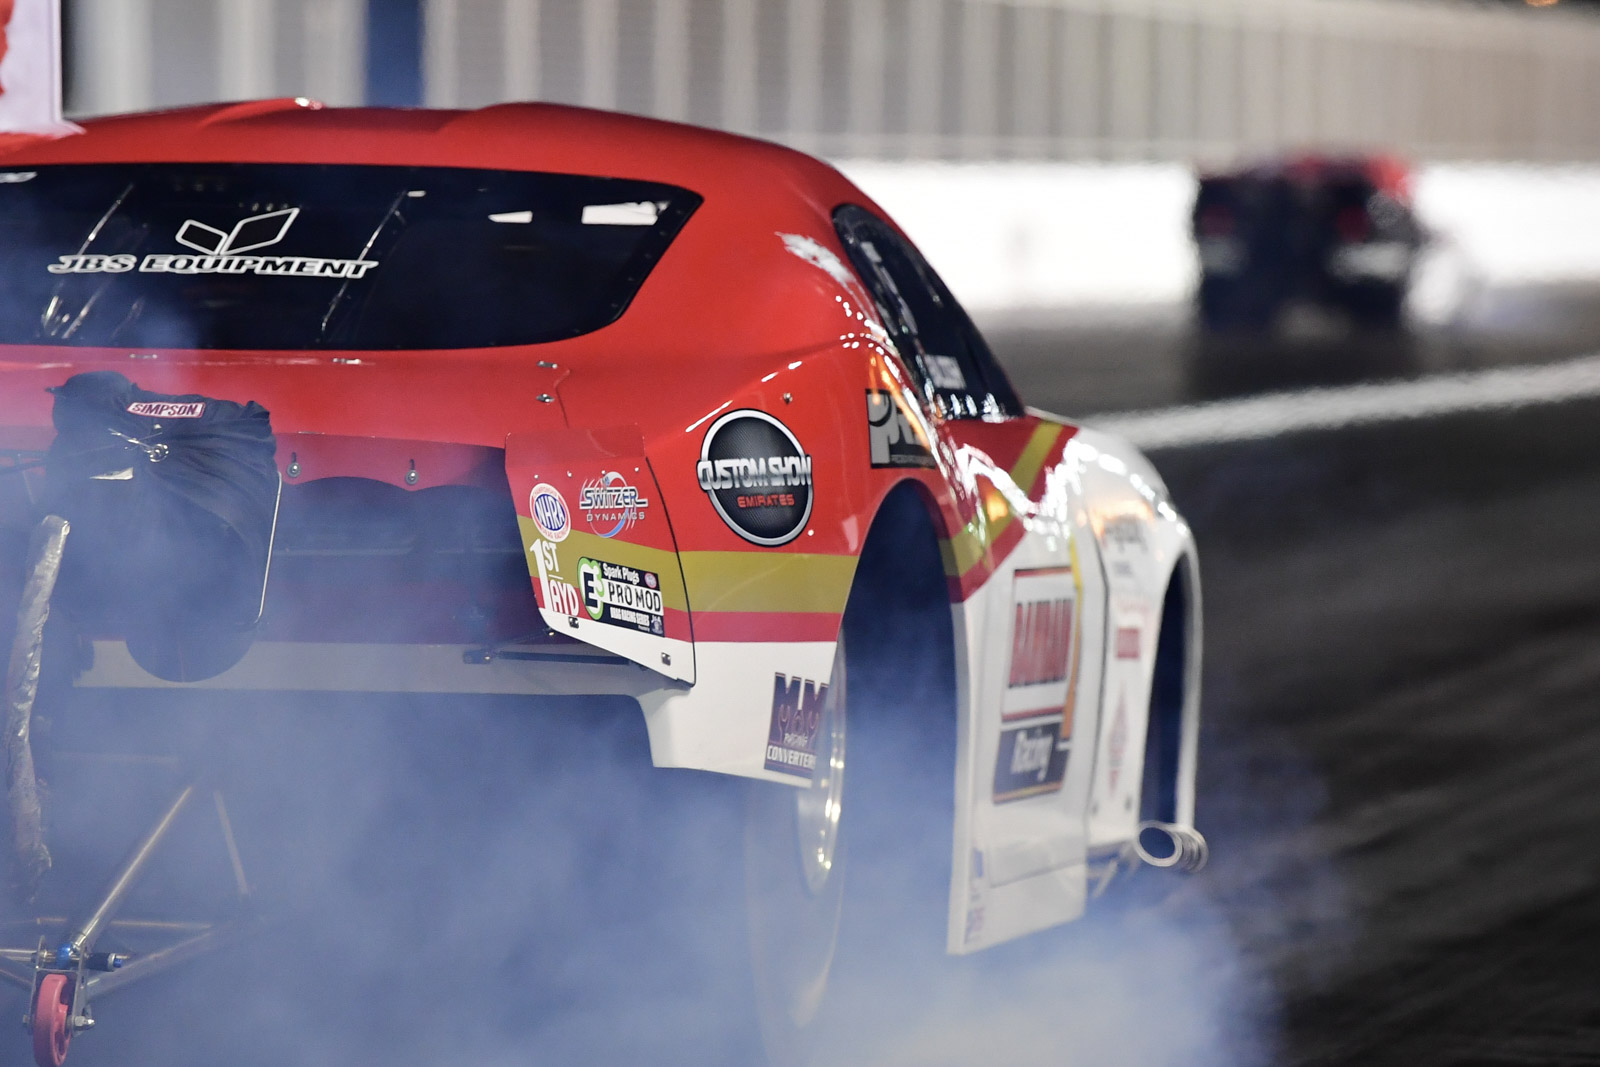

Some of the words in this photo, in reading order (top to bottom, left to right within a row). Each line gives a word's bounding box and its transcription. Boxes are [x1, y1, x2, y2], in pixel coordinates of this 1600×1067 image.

[47, 254, 137, 274] JBS
[139, 254, 379, 278] EQUIPMENT
[132, 403, 198, 416] SIMPSON
[697, 459, 767, 491] CUSTOM
[579, 486, 648, 509] SWITZER
[737, 494, 795, 508] EMIRATES
[534, 494, 566, 531] NHRA
[586, 511, 645, 522] DYNAMICS
[602, 562, 622, 580] Spark
[622, 566, 640, 585] Plugs
[550, 578, 580, 616] AYD
[607, 581, 633, 606] PRO
[634, 588, 661, 612] MOD
